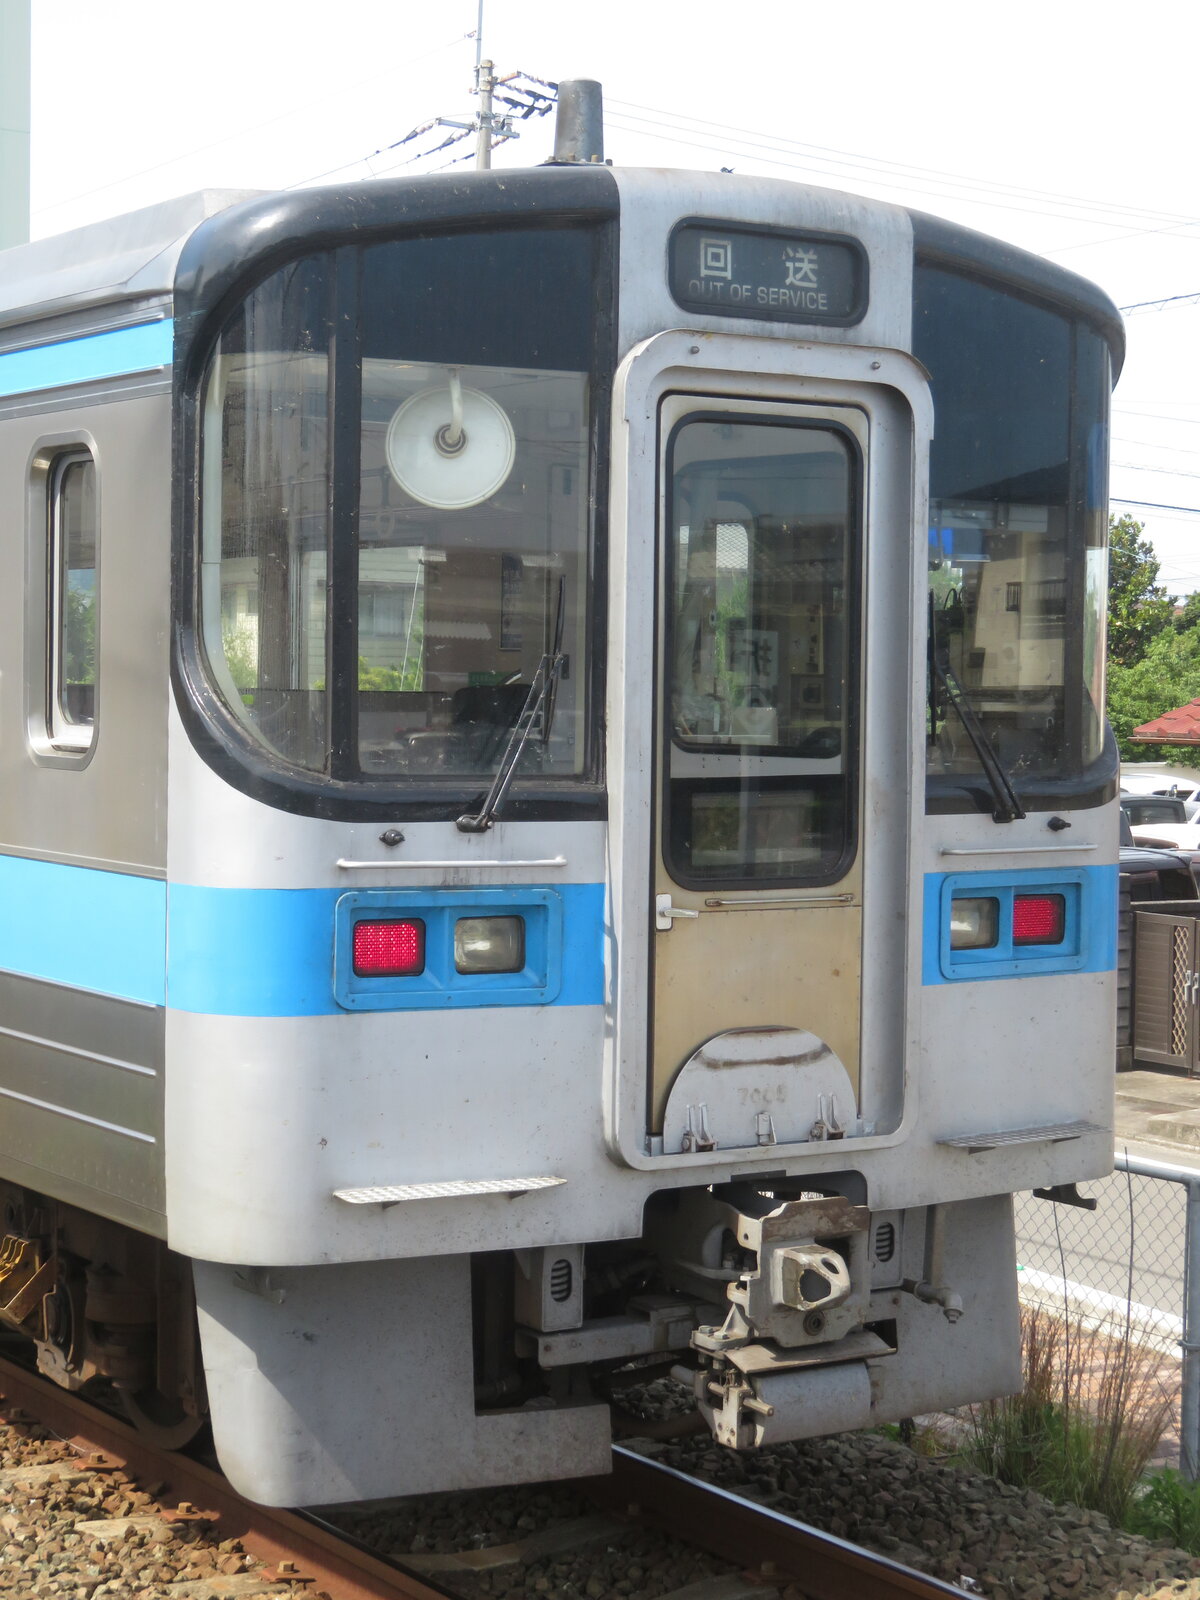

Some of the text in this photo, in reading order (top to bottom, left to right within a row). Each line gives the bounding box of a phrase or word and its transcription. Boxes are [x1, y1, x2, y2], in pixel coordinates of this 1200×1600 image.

[700, 237, 819, 289] 回送
[688, 279, 828, 311] OUT OF SERVICE
